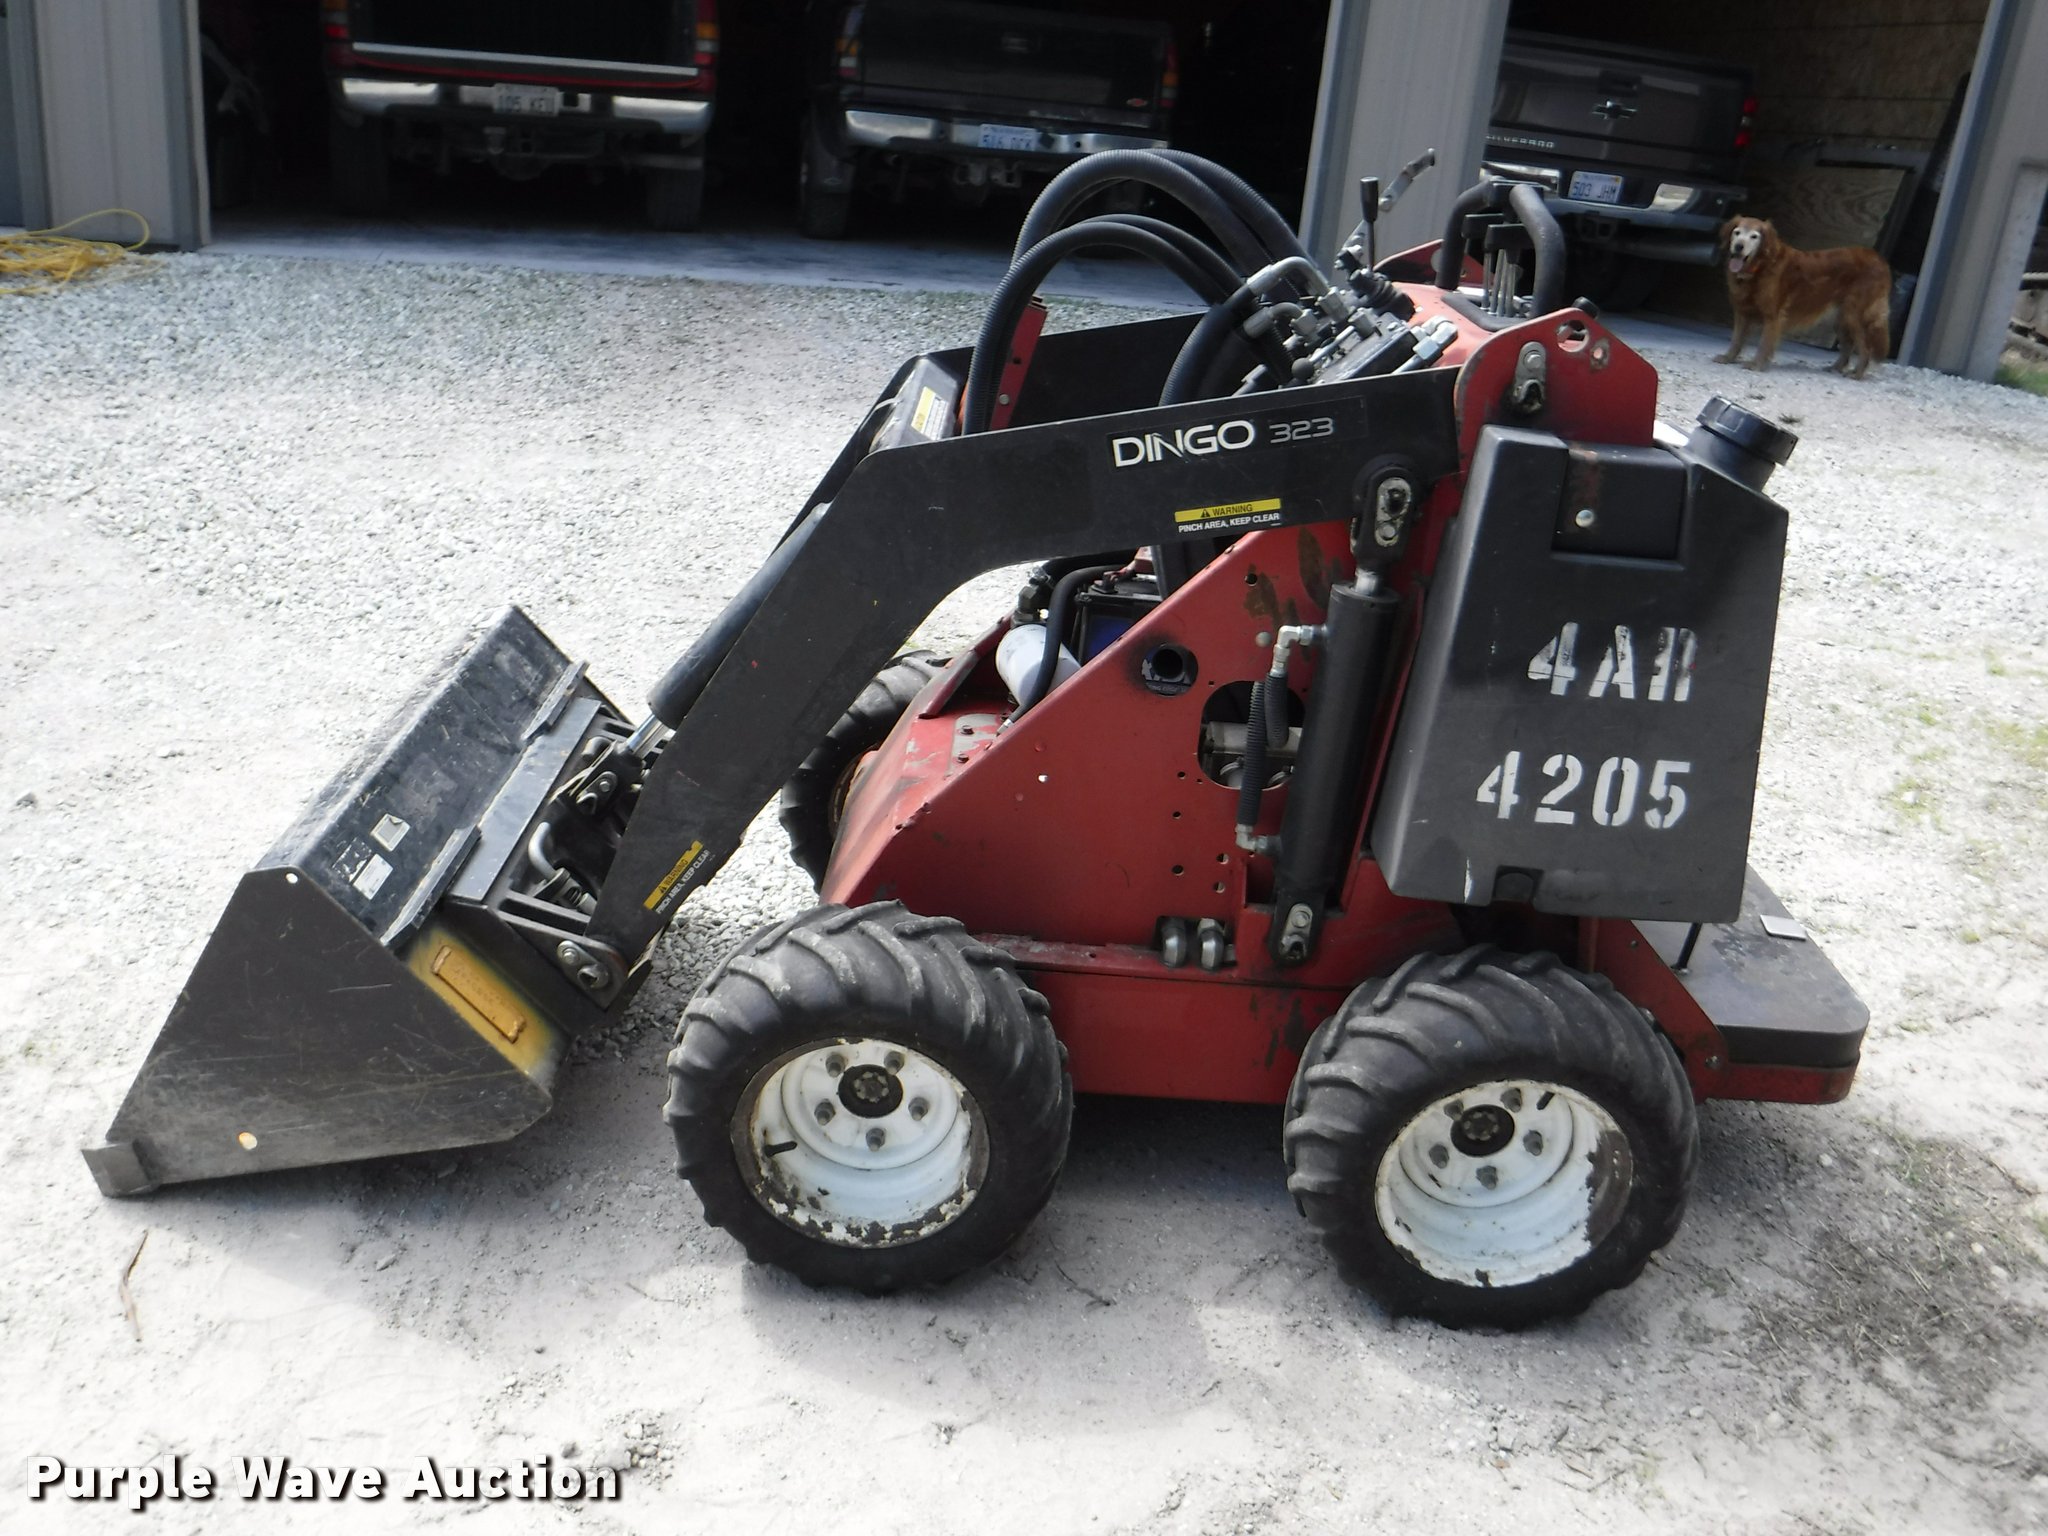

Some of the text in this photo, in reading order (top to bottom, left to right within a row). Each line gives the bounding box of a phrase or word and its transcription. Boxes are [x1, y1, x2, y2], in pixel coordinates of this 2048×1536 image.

[1112, 417, 1334, 467] DINGO 323
[1212, 504, 1253, 517] WARNING
[1178, 513, 1280, 533] PINCH AREA, KEEP CLEAR
[1476, 751, 1692, 829] 4205
[664, 859, 689, 886] WARNING
[681, 867, 695, 882] KEEP
